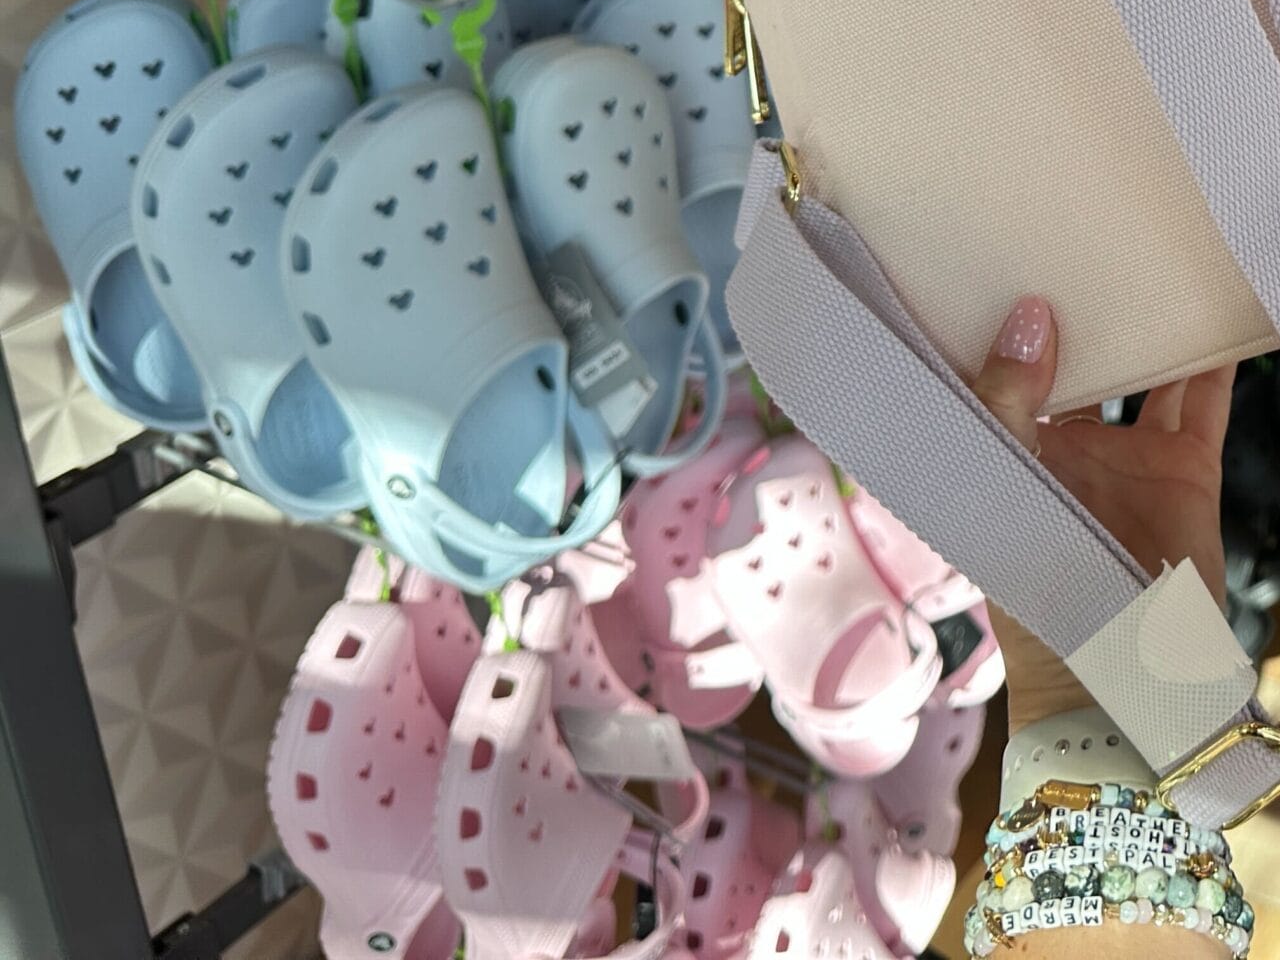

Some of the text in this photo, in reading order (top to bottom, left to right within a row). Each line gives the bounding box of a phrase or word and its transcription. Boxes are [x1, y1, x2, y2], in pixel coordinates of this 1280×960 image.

[1055, 808, 1183, 836] BREATHE
[1028, 846, 1173, 870] BEST PAL
